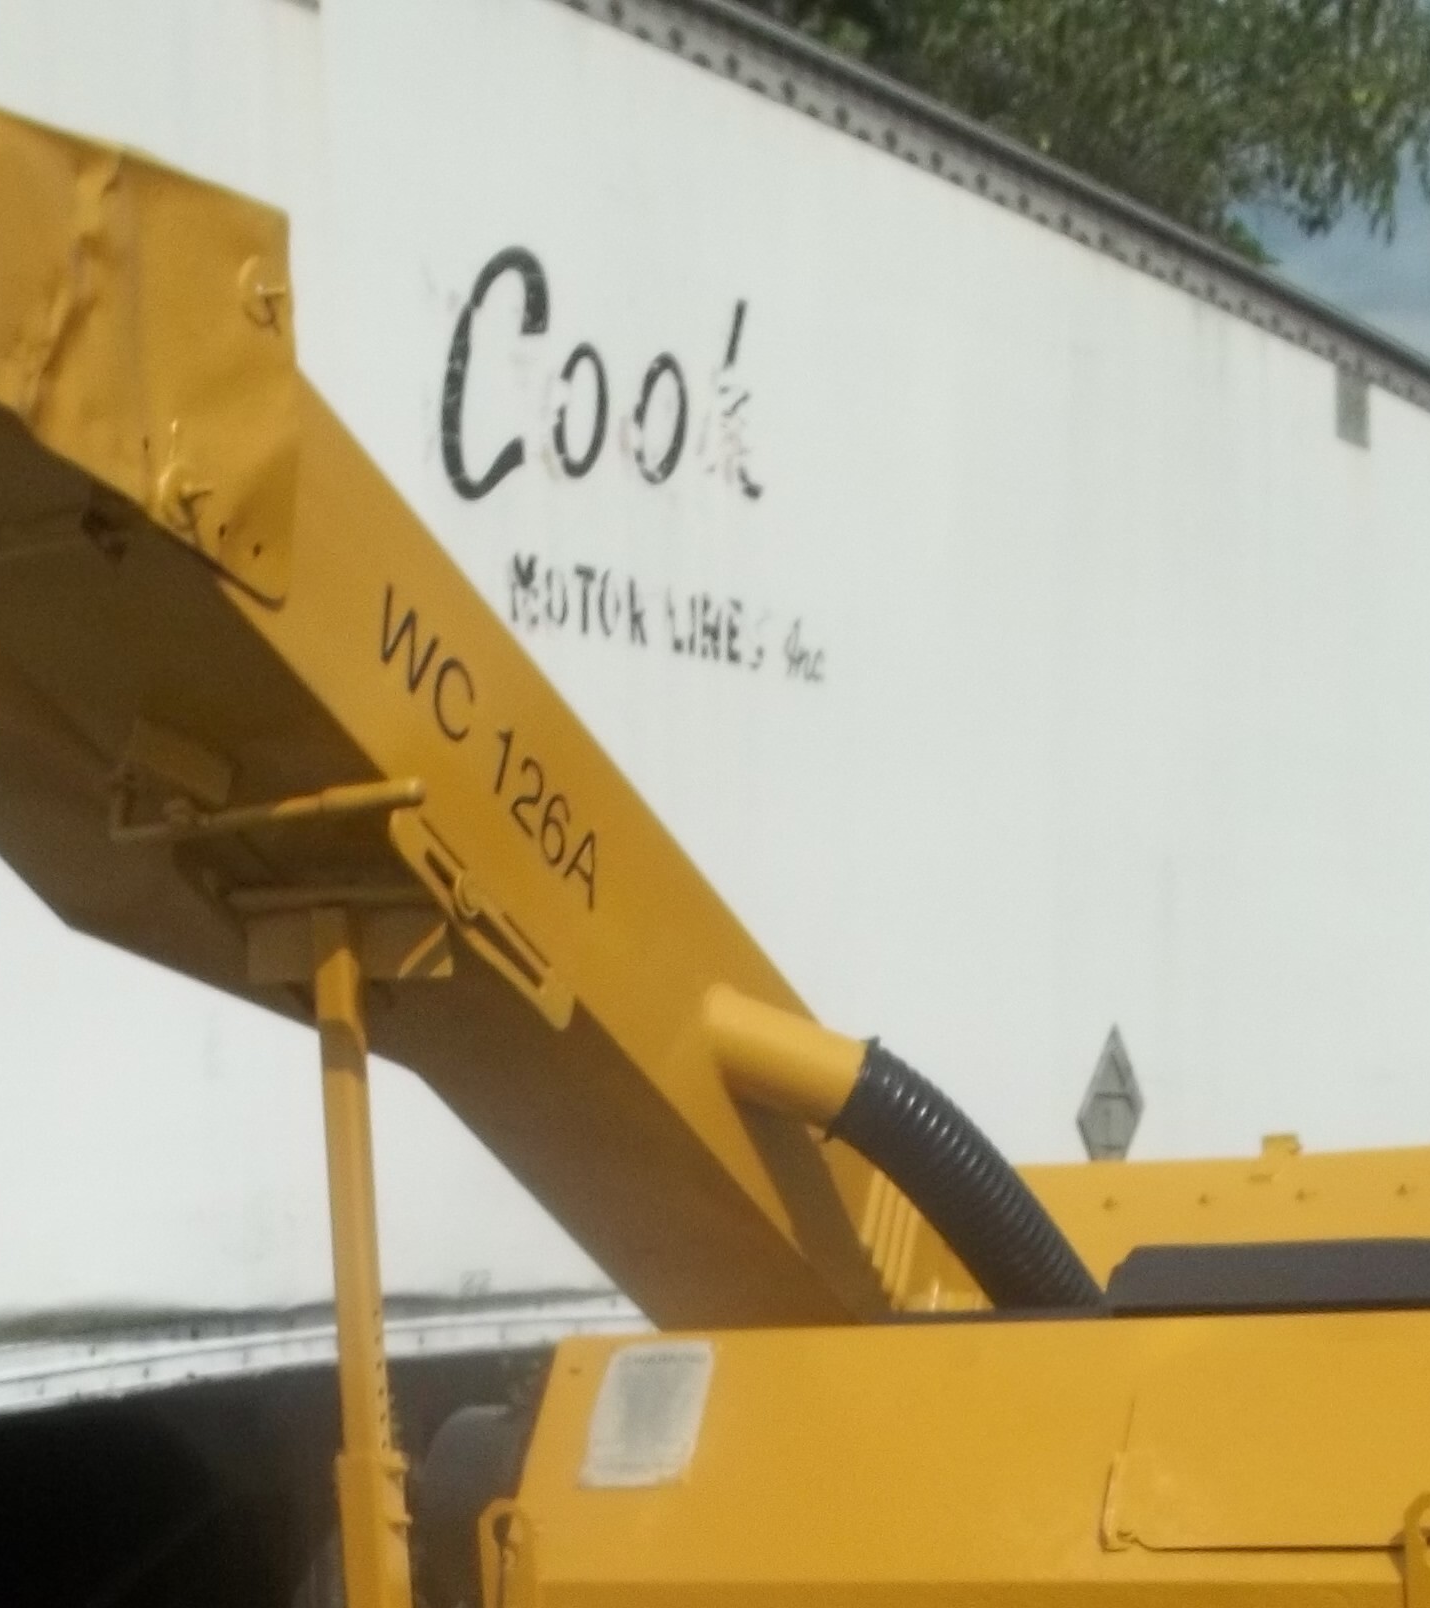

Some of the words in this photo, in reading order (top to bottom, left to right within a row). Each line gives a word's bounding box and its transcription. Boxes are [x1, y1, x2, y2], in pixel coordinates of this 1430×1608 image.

[441, 245, 763, 501] Cook
[509, 551, 648, 648] MOTOR
[379, 582, 476, 742] WC
[492, 727, 597, 914] 126A
